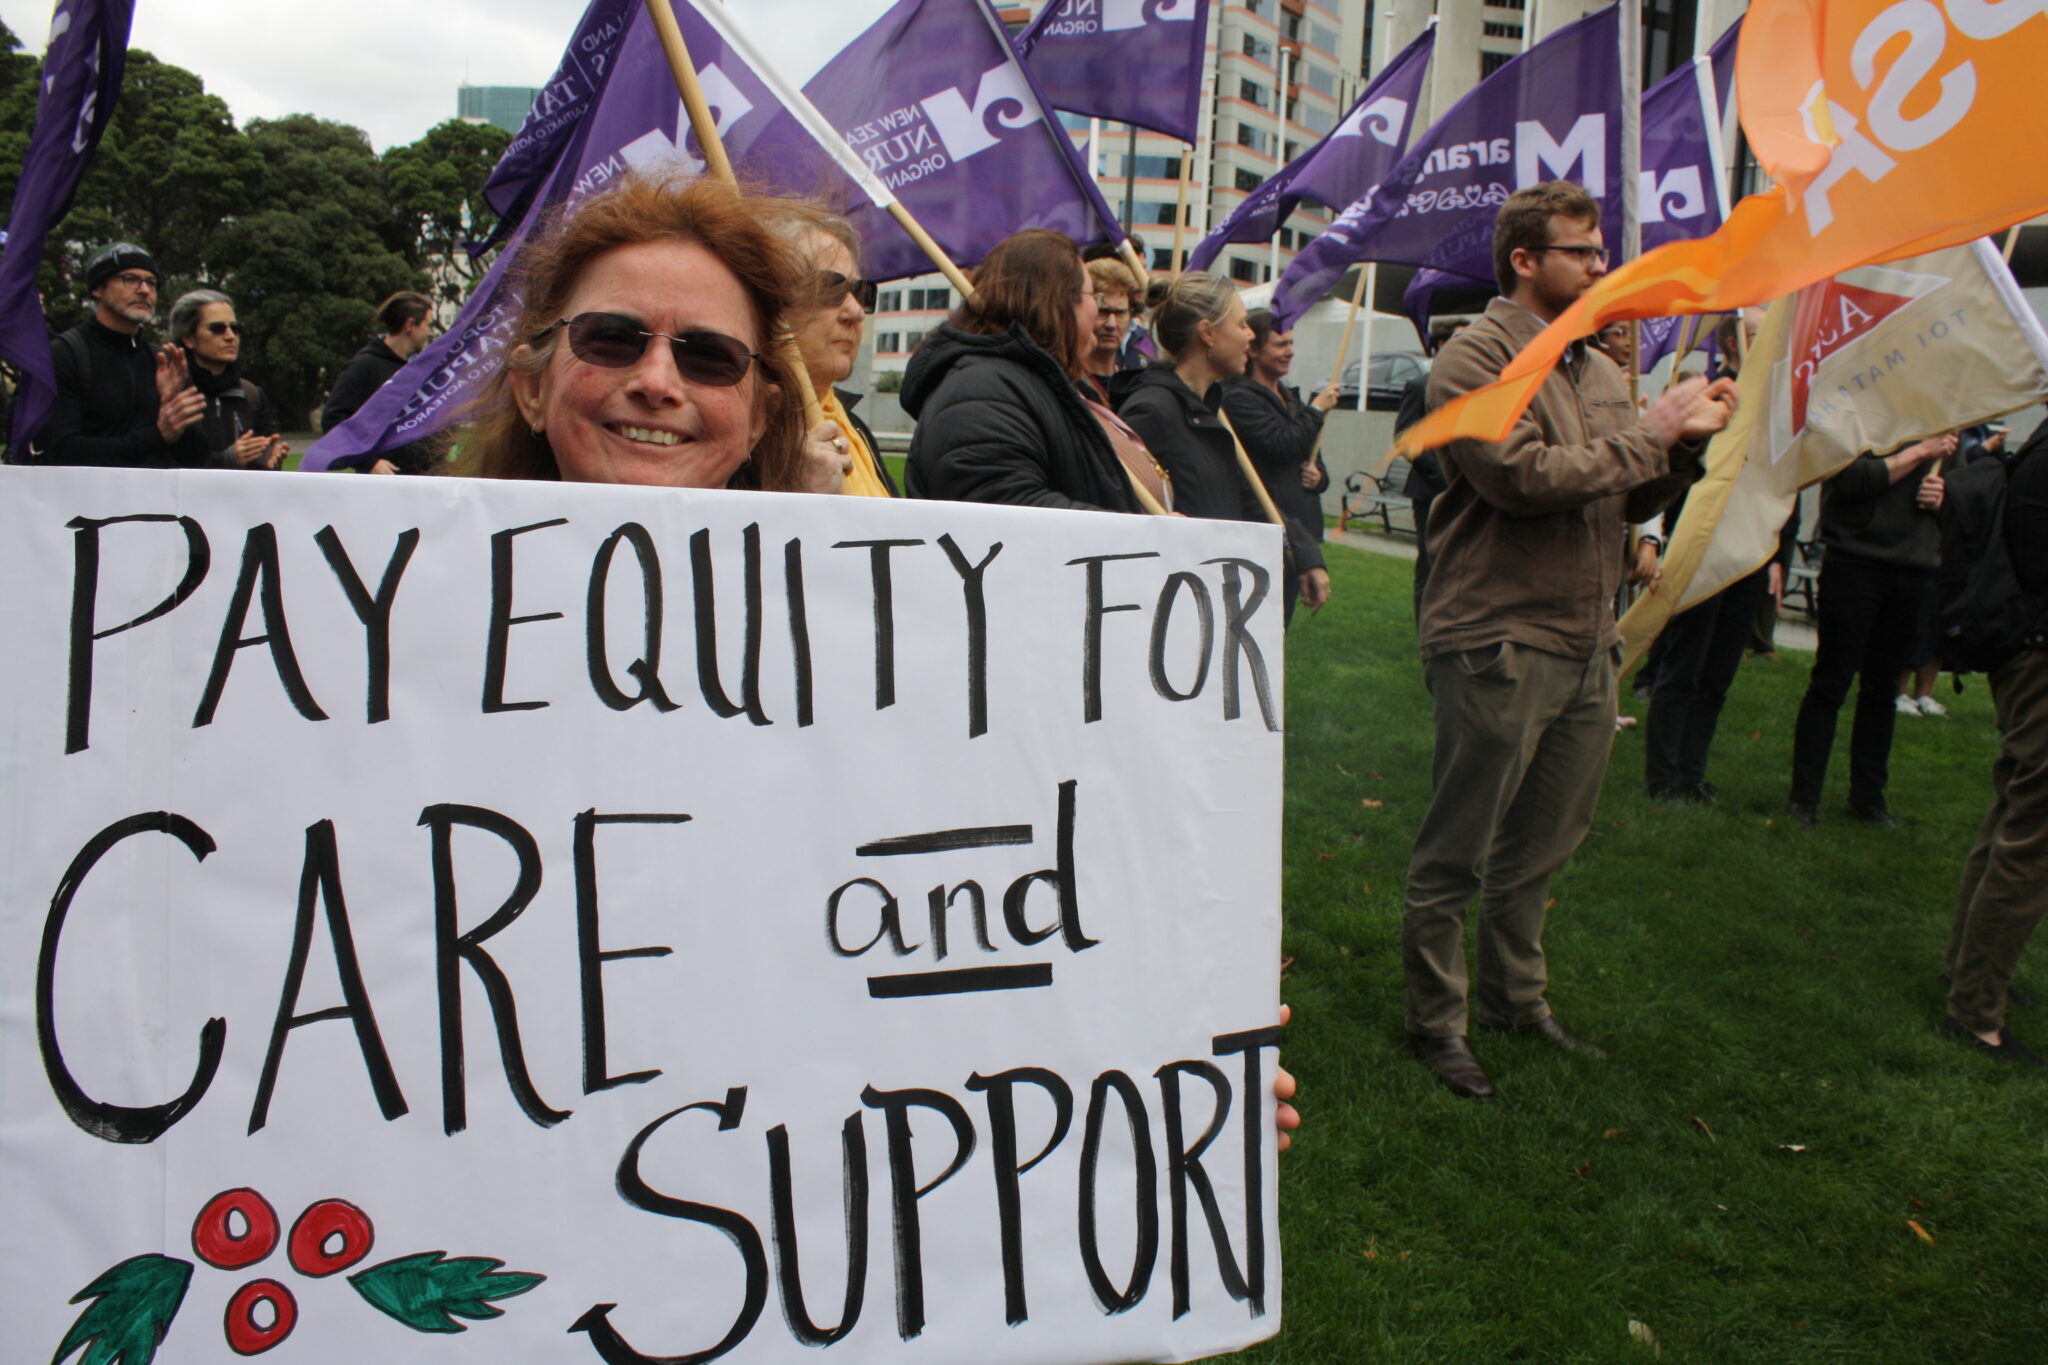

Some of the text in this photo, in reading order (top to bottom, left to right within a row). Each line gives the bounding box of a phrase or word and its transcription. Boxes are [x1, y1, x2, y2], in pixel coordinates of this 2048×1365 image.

[64, 513, 1284, 755] PAY EQUITY FOR
[35, 778, 1104, 1145] CARE and
[566, 1025, 1281, 1365] SUPPORT
